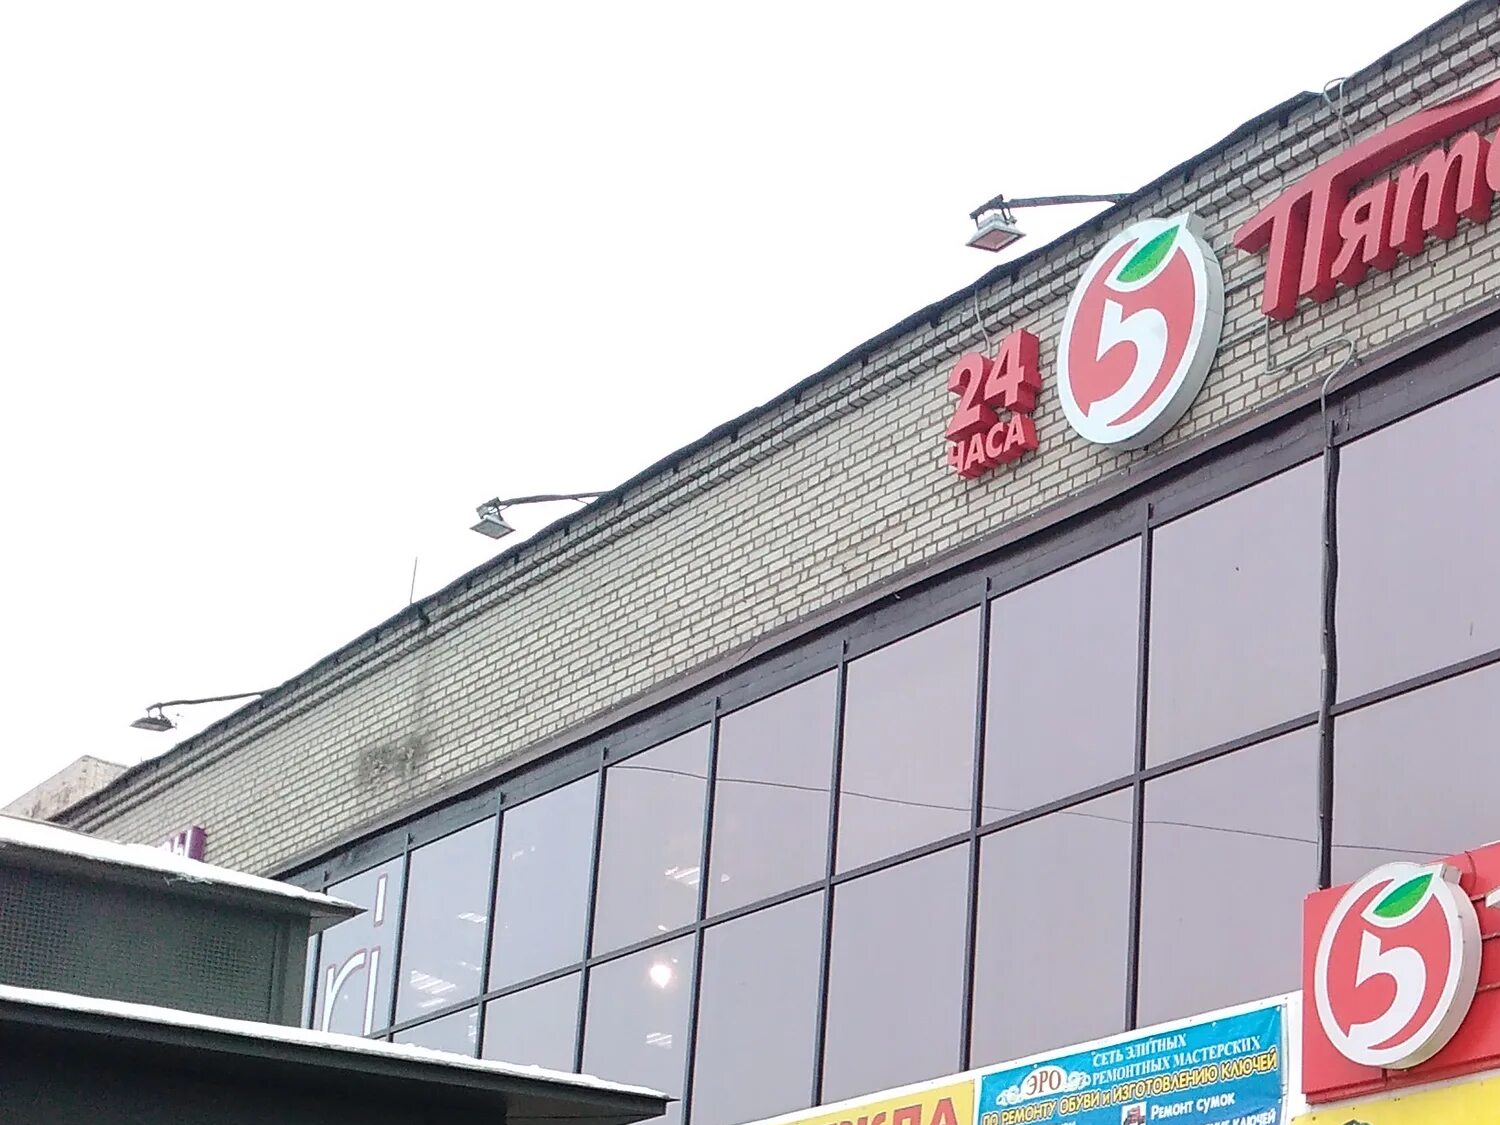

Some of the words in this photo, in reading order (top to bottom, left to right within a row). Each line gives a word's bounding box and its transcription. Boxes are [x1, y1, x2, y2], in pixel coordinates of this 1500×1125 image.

[948, 328, 1038, 436] 24
[950, 413, 1036, 475] ЧАСА
[1093, 1049, 1124, 1067] СЕТЬ
[1126, 1033, 1187, 1059] ЭЛИТНЫХ
[1093, 1056, 1171, 1086] РЕМОНТНЫХ
[1173, 1035, 1261, 1068] МАСТЕРСКИХ
[1001, 1101, 1057, 1125] РЕМОНТУ
[1060, 1090, 1100, 1115] ОБУВИ
[1113, 1066, 1218, 1103] ИЗГОТОВЛЕНИЮ
[1221, 1045, 1278, 1080] КЛЮЧЕЙ
[1026, 1069, 1062, 1095] ЭРО
